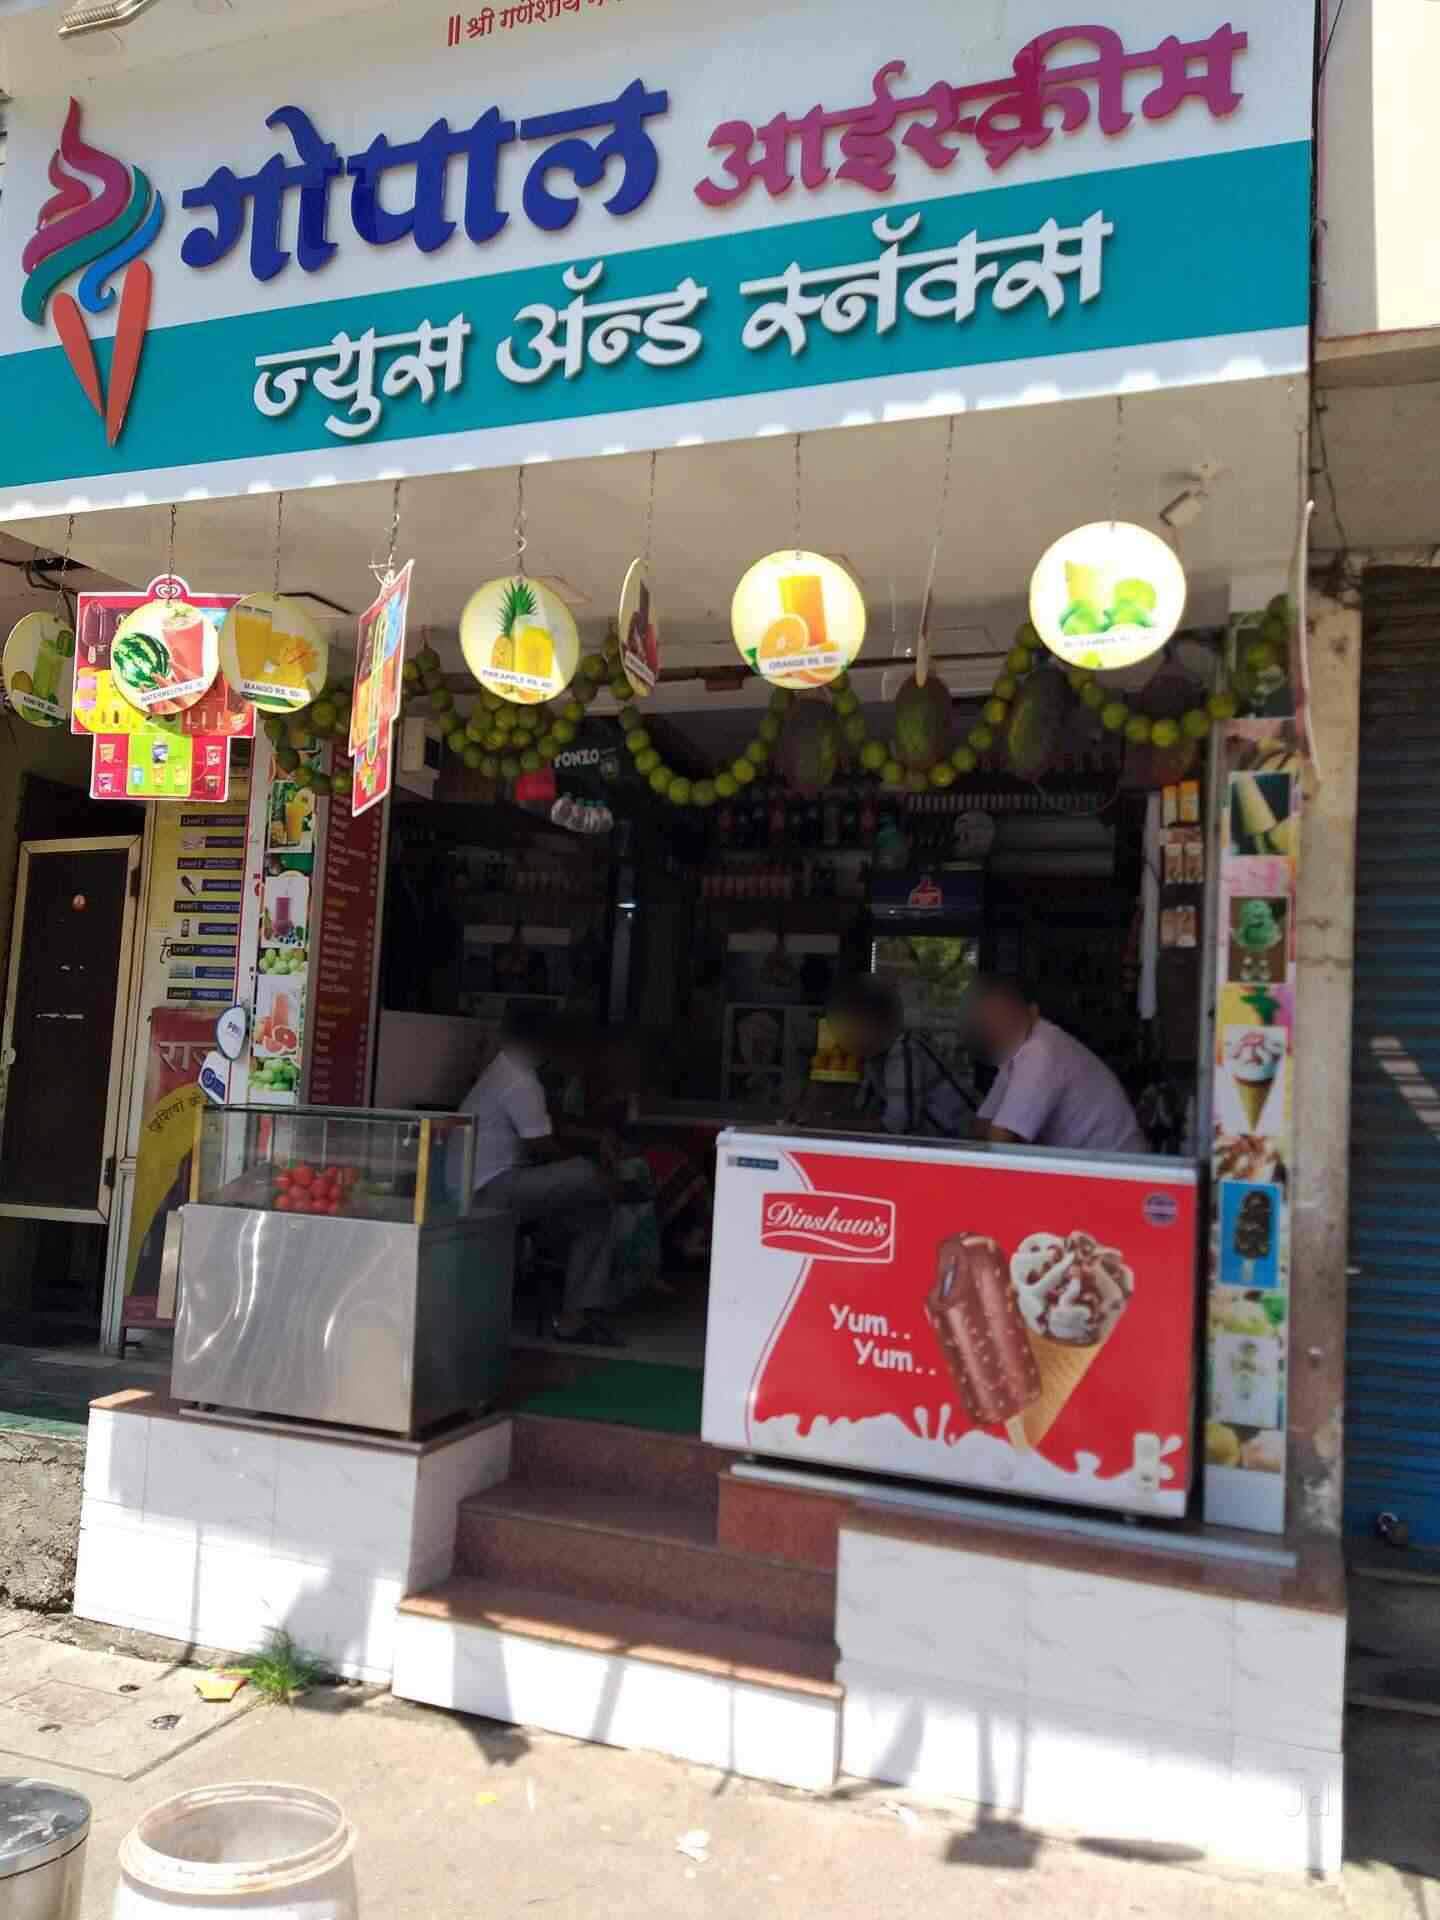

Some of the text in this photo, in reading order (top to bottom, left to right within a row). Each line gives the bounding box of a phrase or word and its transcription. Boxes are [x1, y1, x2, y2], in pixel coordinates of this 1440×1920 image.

[181, 22, 1248, 281] गोपाल आईस्क्रीम
[740, 210, 1113, 356] स्नॅक्स
[244, 682, 273, 693] MANGO
[766, 1200, 889, 1237] Dinshaw's
